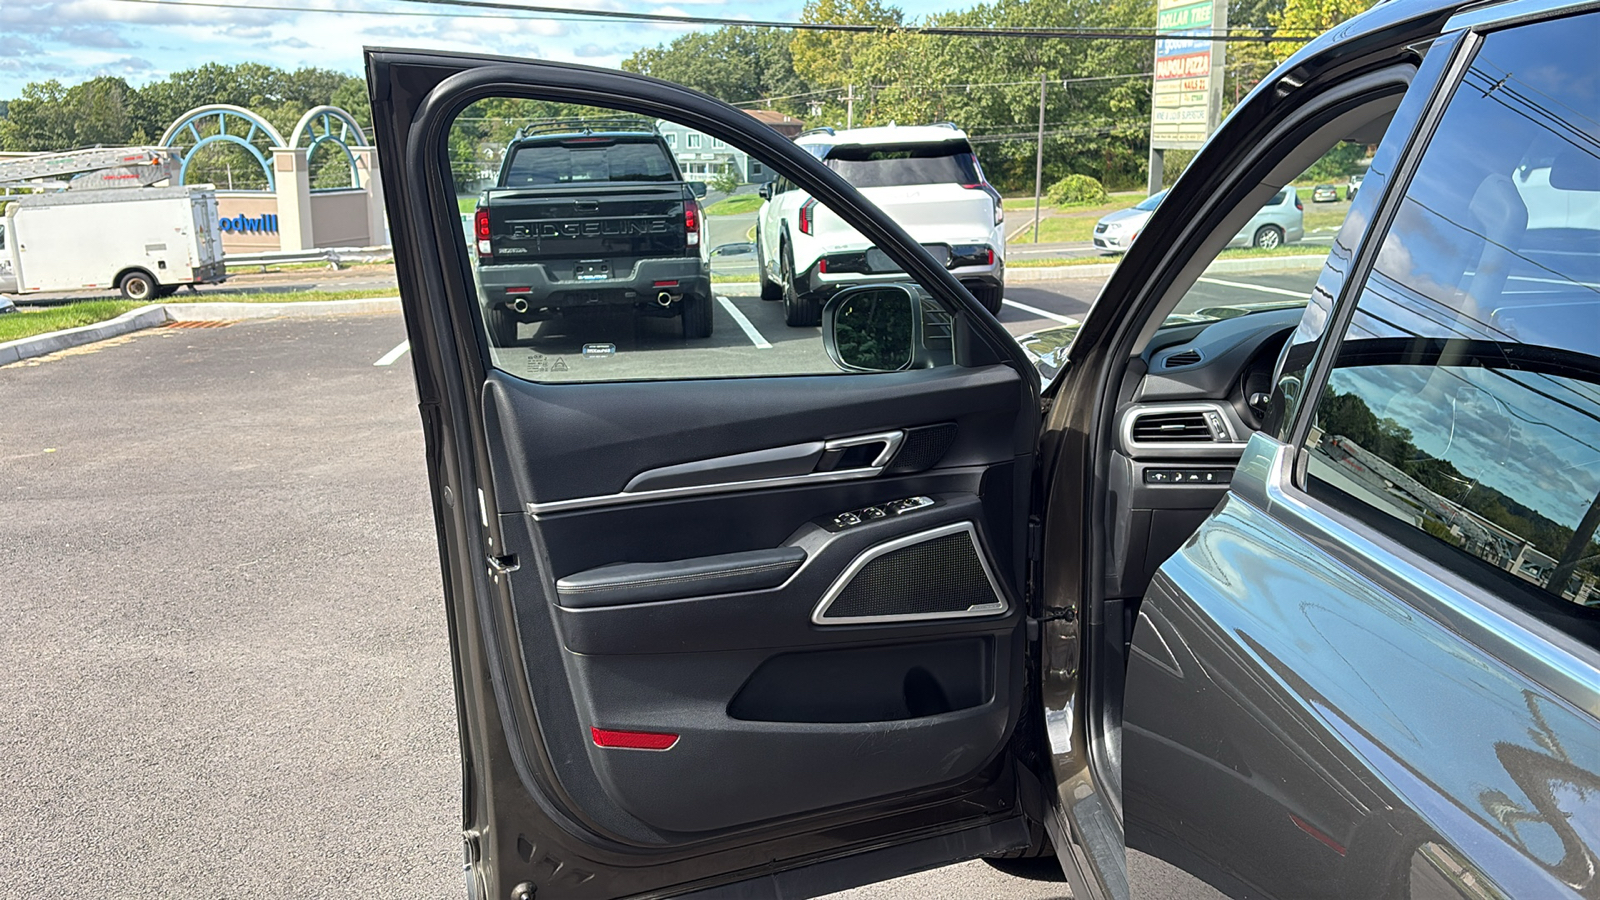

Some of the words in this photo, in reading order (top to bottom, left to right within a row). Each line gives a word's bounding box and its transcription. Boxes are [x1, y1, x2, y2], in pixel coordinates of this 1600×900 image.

[1160, 9, 1189, 29] DOLLAR
[1191, 5, 1212, 24] TREE
[1157, 58, 1185, 77] NAPOLI
[1185, 55, 1208, 75] PIZZA
[219, 213, 278, 232] odwill
[511, 219, 668, 239] RIDGELINE
